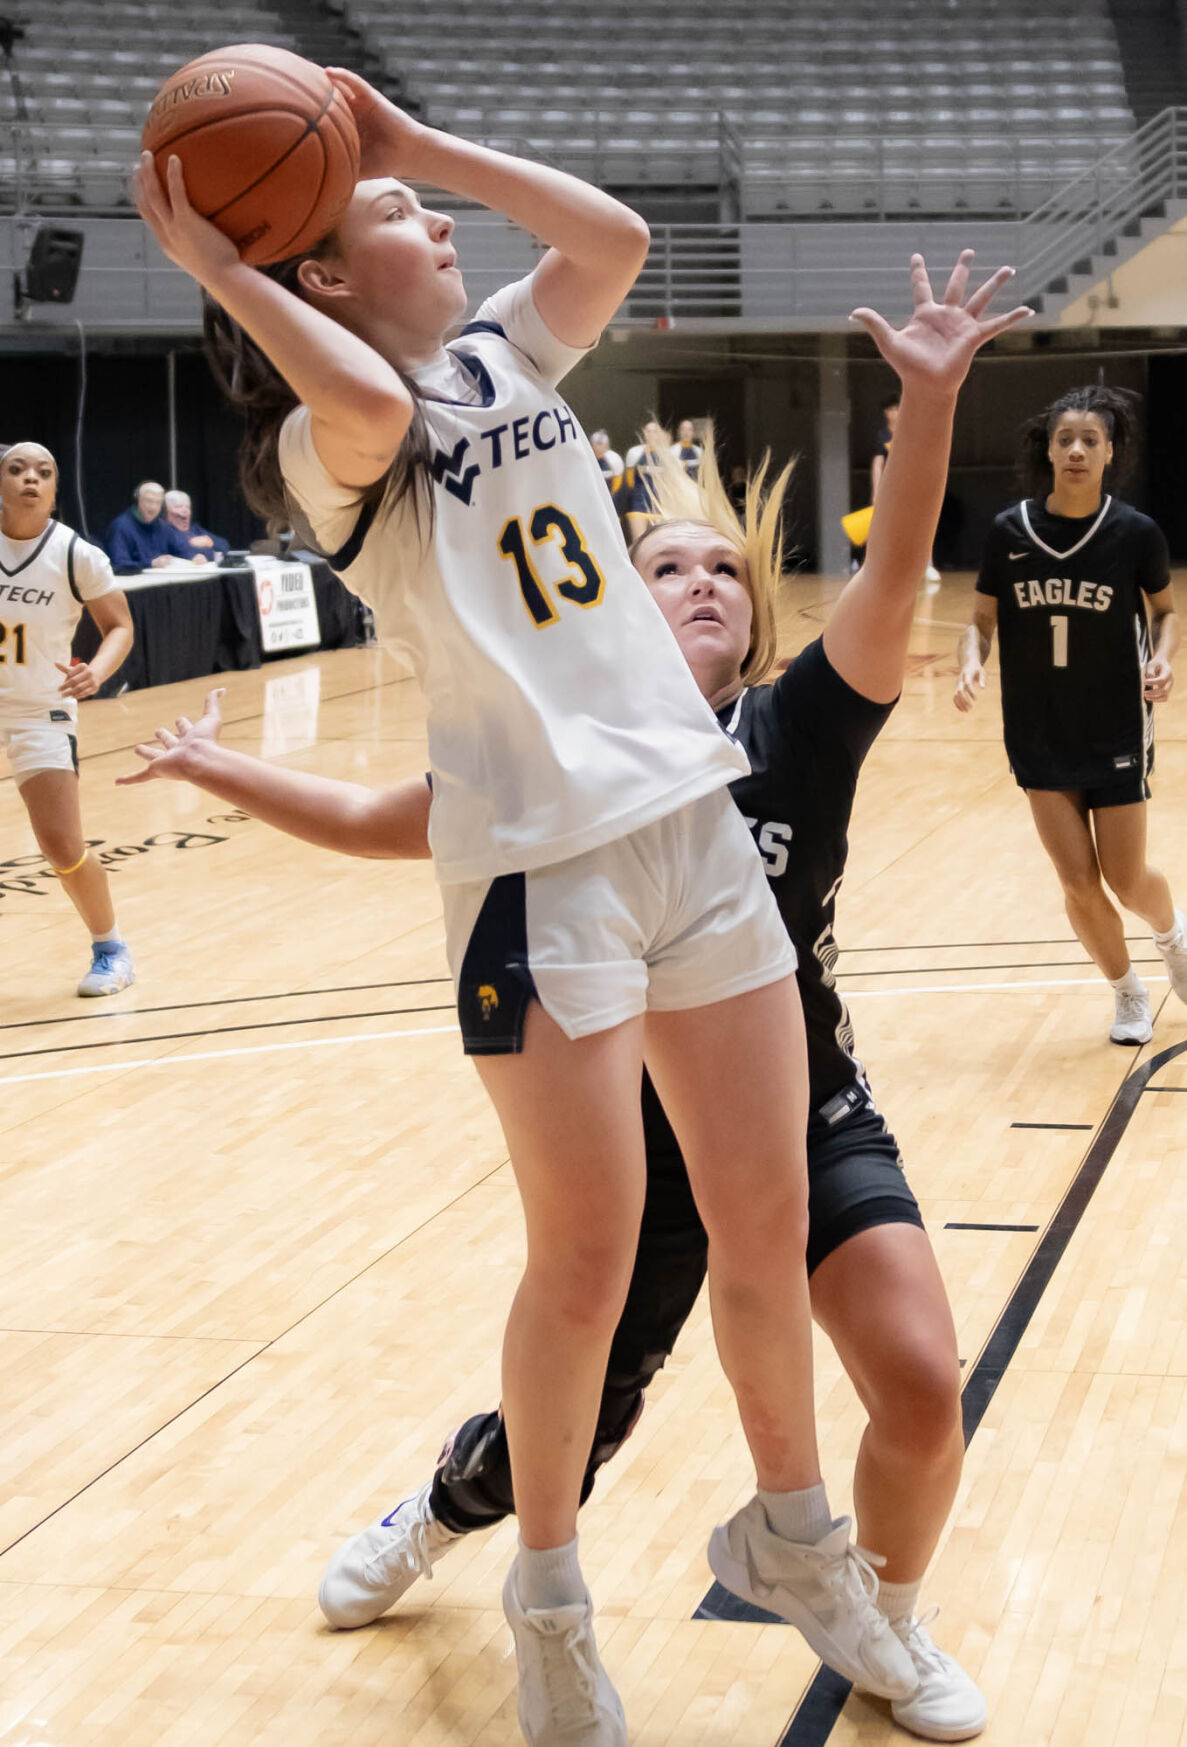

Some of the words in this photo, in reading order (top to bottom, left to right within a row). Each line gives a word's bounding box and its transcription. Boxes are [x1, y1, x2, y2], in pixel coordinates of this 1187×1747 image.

[480, 405, 578, 469] TECH
[496, 501, 607, 631] 13
[1013, 578, 1114, 612] EAGLES
[1050, 615, 1069, 667] 1
